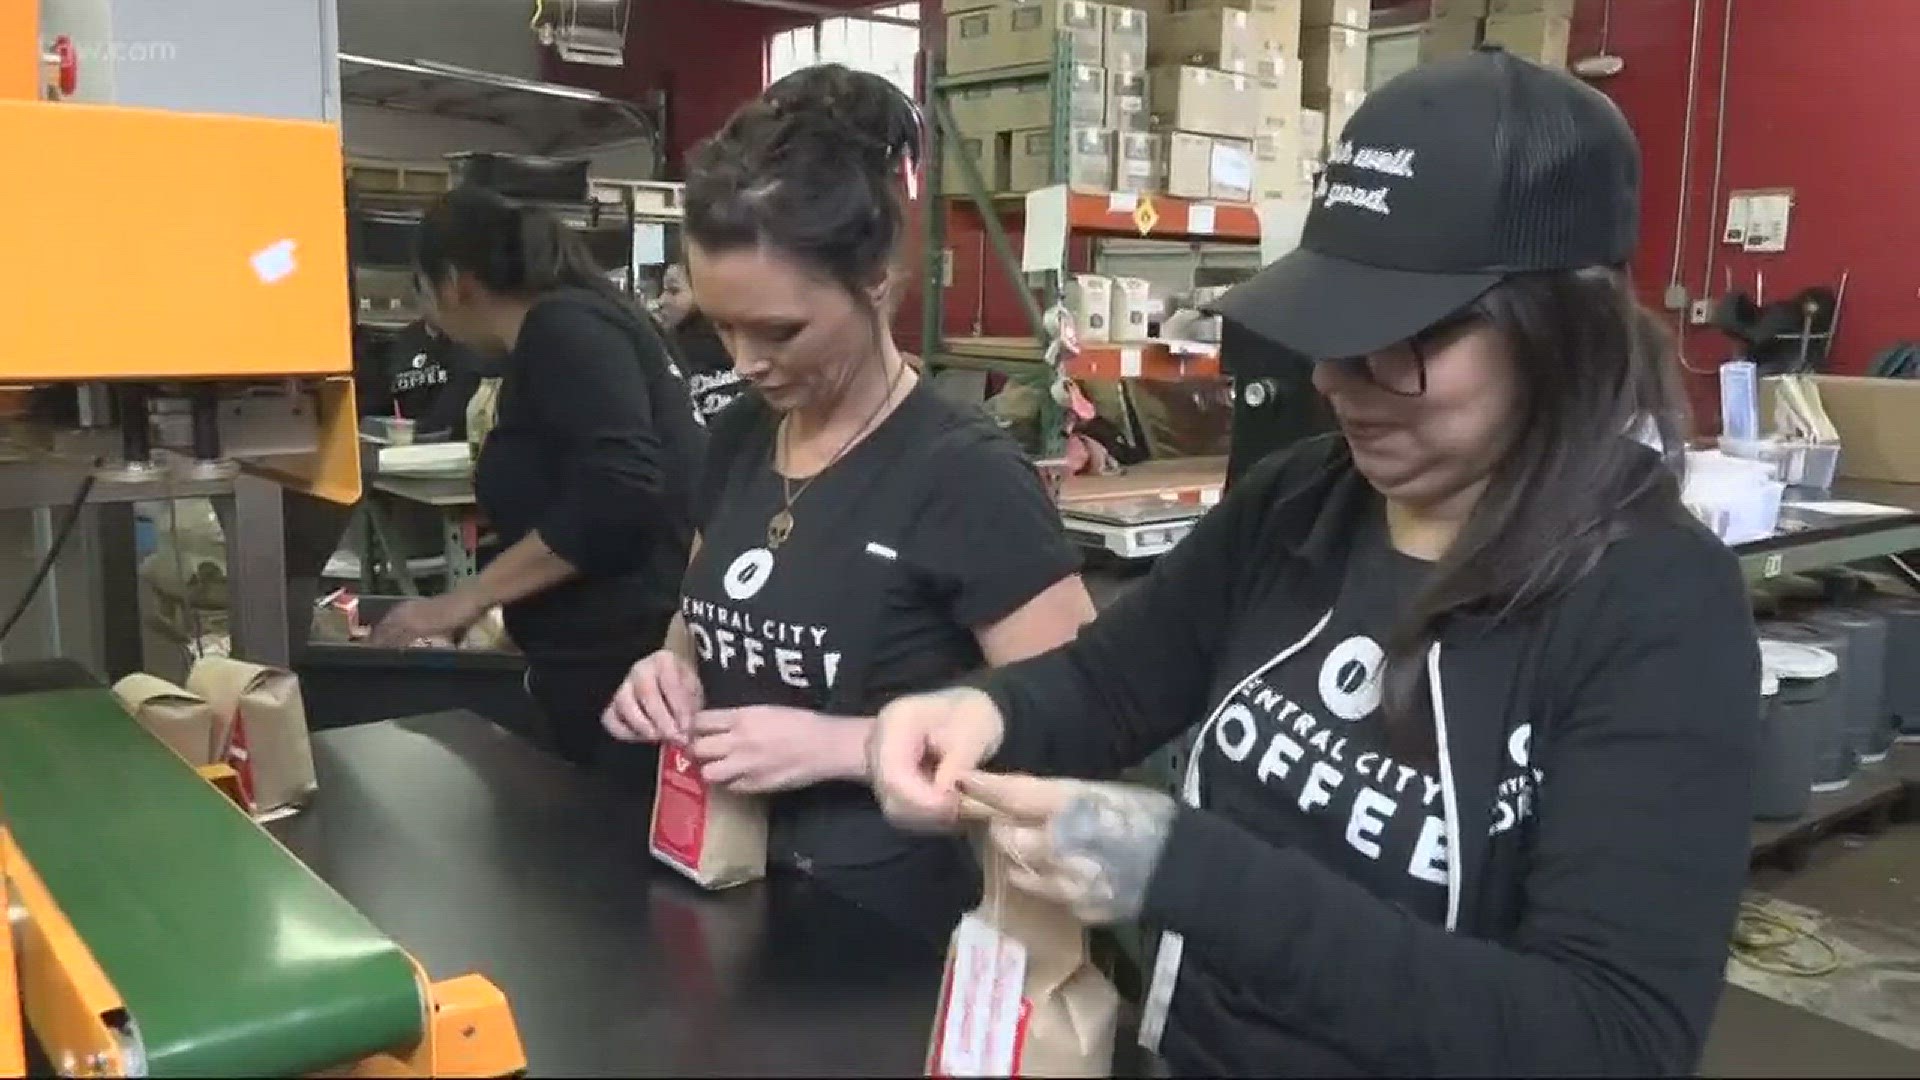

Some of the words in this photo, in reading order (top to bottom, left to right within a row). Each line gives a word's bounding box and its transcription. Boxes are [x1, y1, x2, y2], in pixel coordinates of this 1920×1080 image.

[682, 595, 753, 633] ENTRAL
[762, 619, 828, 648] CITY
[689, 622, 842, 688] OFFE
[1240, 677, 1348, 761] ENTRAL
[1355, 751, 1441, 806] CITY
[1216, 702, 1449, 886] OFFEE
